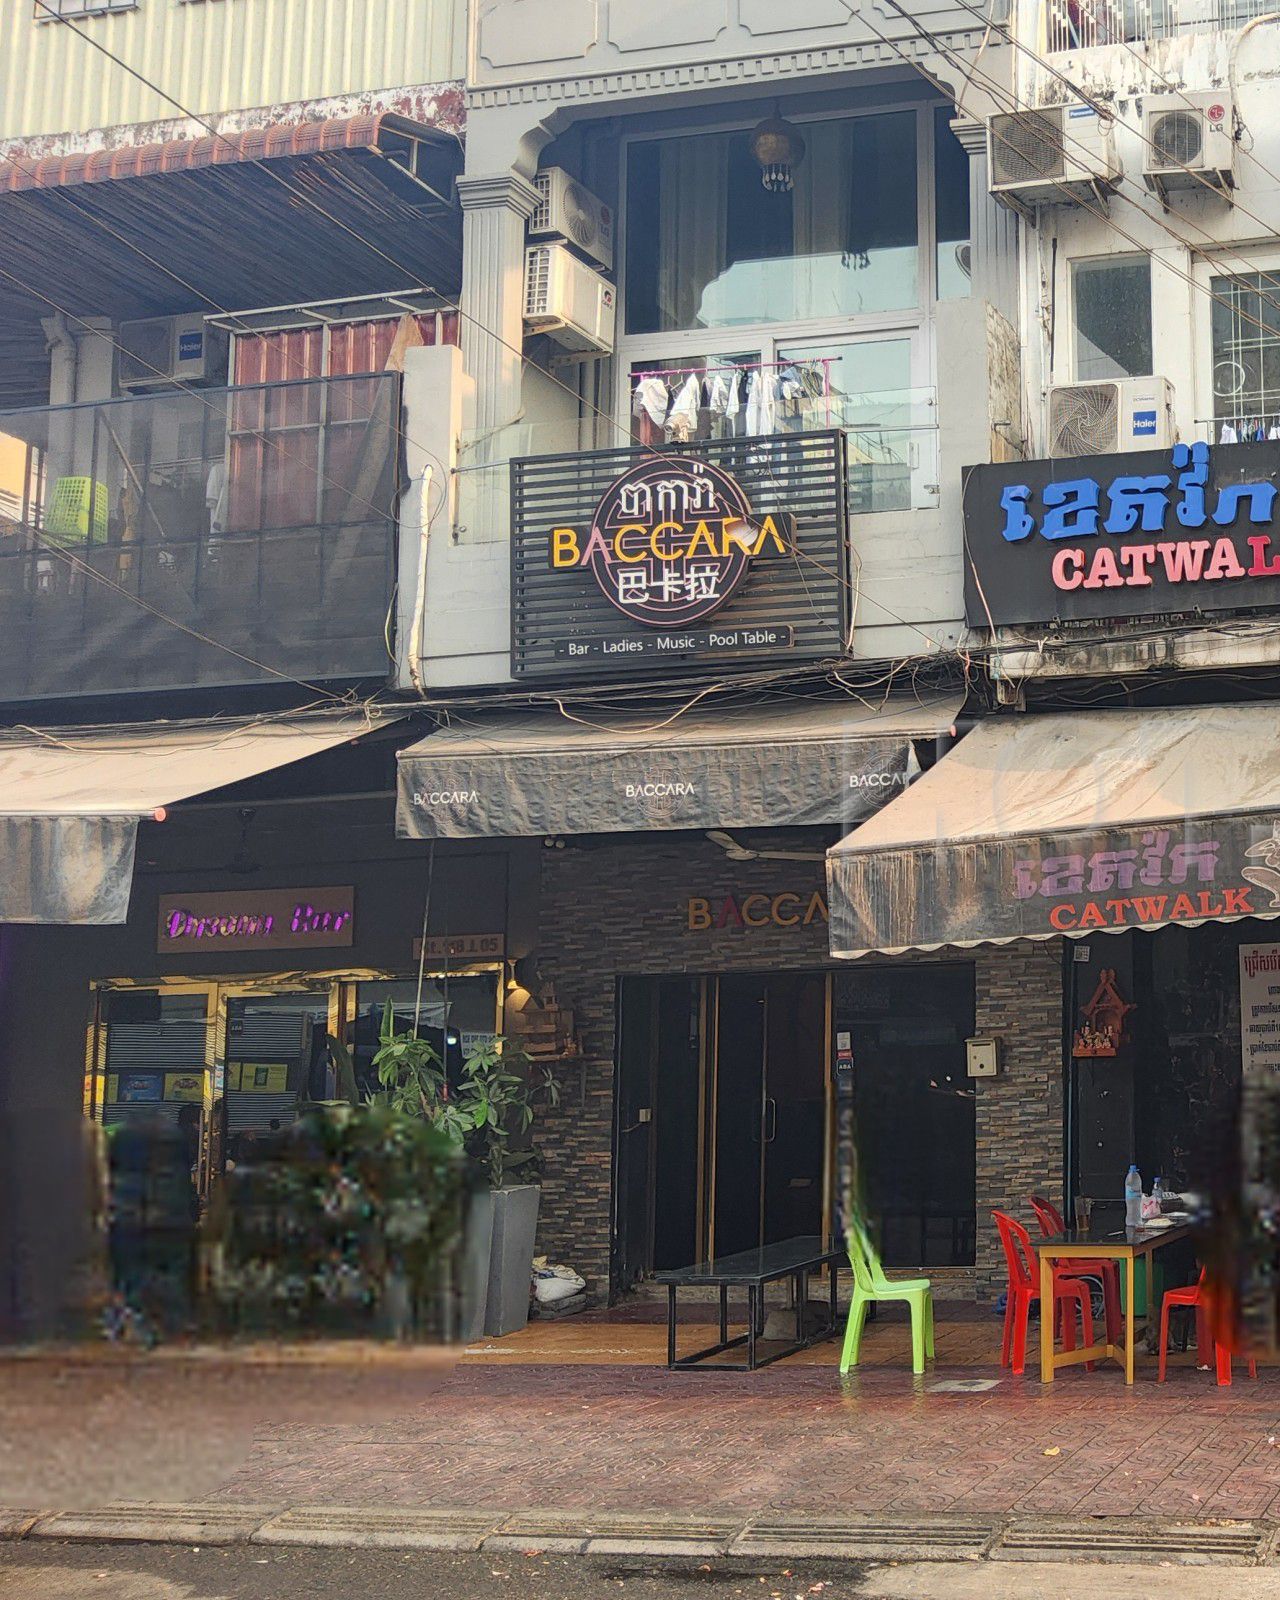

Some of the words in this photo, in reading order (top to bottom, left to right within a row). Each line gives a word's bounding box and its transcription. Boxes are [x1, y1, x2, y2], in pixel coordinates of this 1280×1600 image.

[1209, 124, 1223, 133] LG
[1133, 419, 1156, 428] Haier
[553, 515, 786, 568] BACCARA
[618, 566, 721, 604] 巴卡拉
[568, 642, 590, 656] Bar
[603, 640, 643, 654] Ladies
[656, 636, 695, 650] Music
[709, 633, 739, 647] Pool
[741, 631, 776, 645] Table
[625, 781, 695, 799] BACCARA
[849, 772, 909, 789] BACCA
[413, 789, 479, 806] BACCARA
[687, 893, 828, 930] BACCA
[1049, 886, 1256, 930] CATWALK
